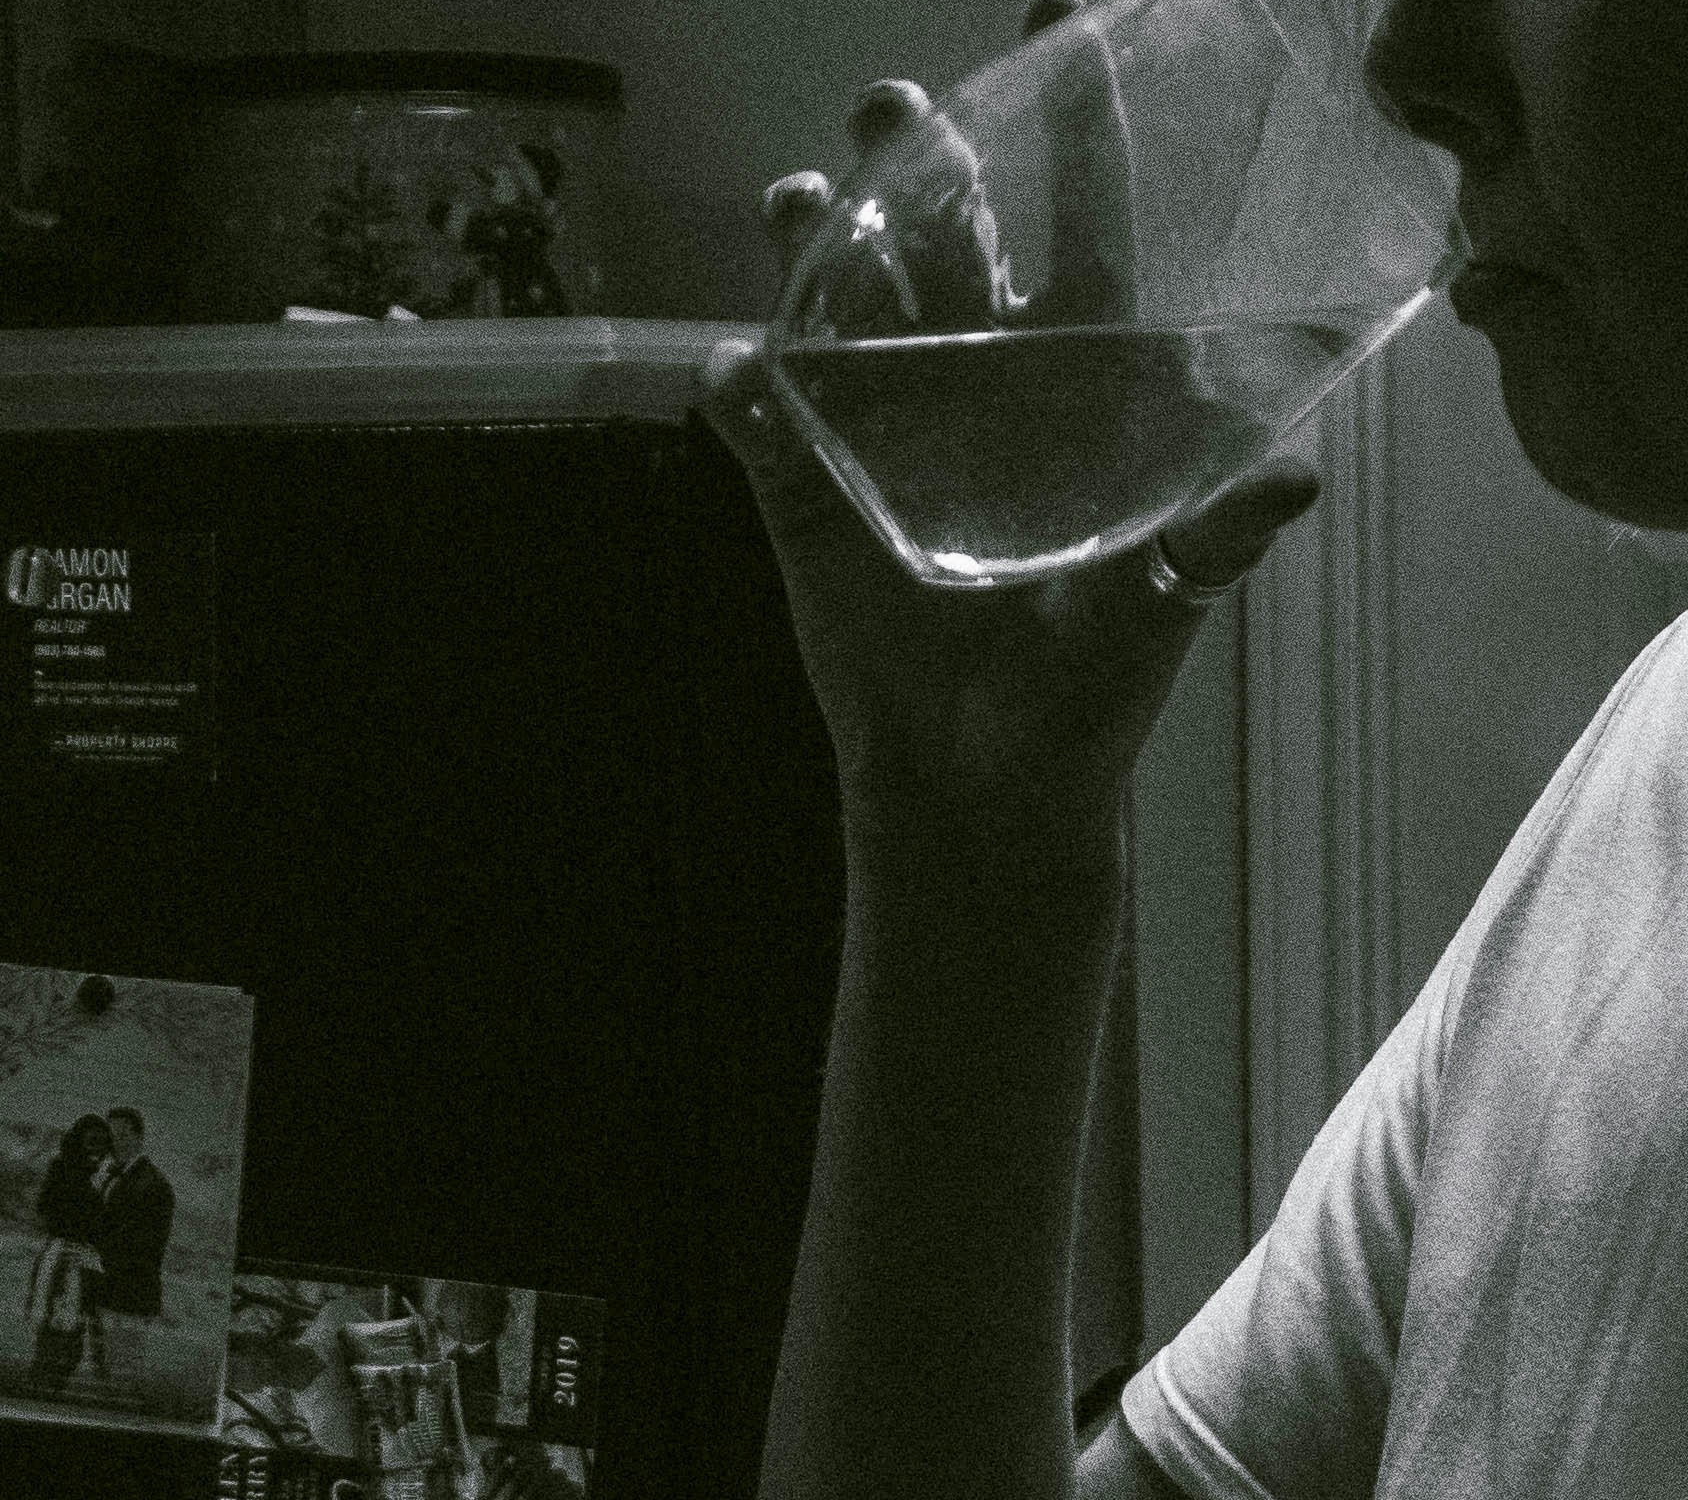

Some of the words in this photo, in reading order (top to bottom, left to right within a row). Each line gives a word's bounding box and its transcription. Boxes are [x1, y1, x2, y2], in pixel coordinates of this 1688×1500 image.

[50, 548, 128, 577] AMON
[46, 582, 131, 613] RGAN
[553, 1335, 579, 1407] 2019
